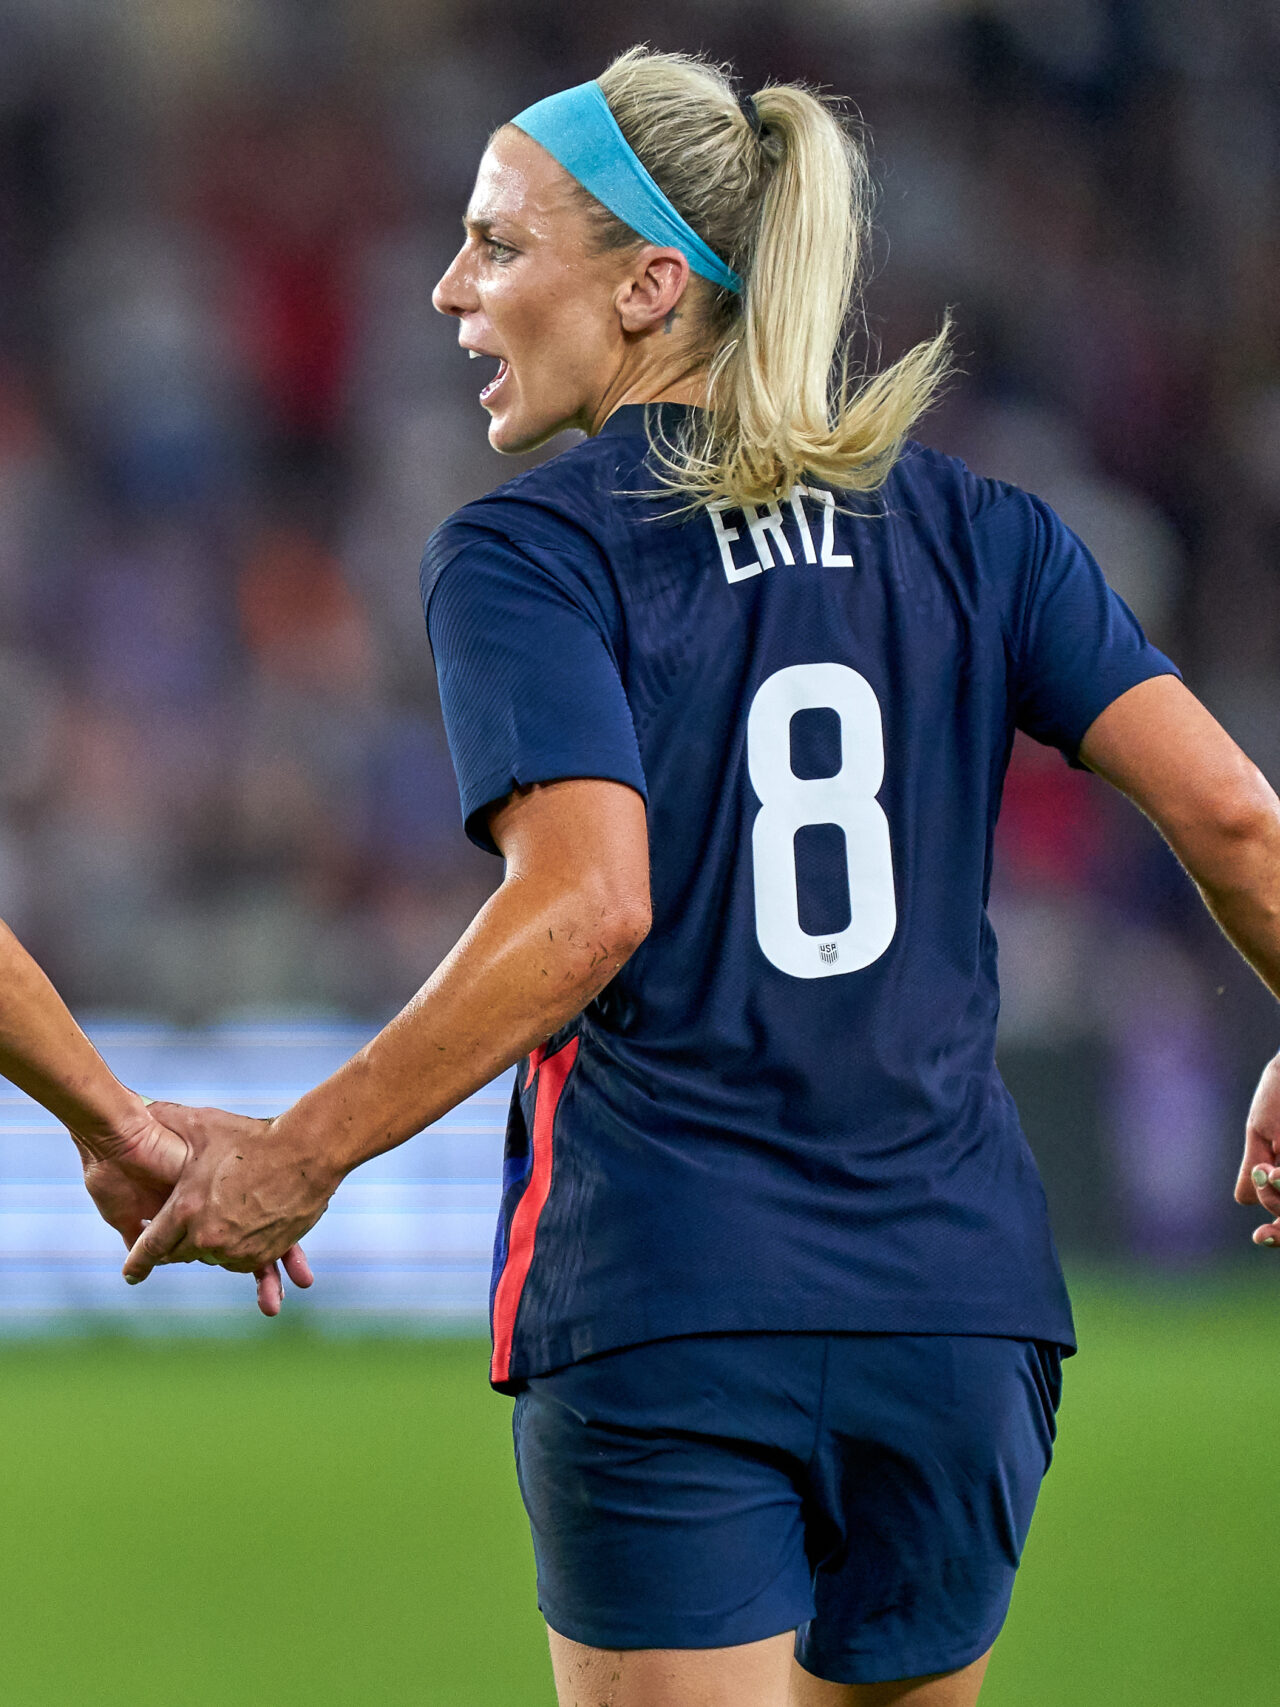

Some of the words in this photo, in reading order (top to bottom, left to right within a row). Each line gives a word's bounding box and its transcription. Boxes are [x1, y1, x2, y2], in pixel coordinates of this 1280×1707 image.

[705, 485, 854, 585] ERTZ
[747, 662, 897, 979] 8
[819, 943, 837, 953] USA
